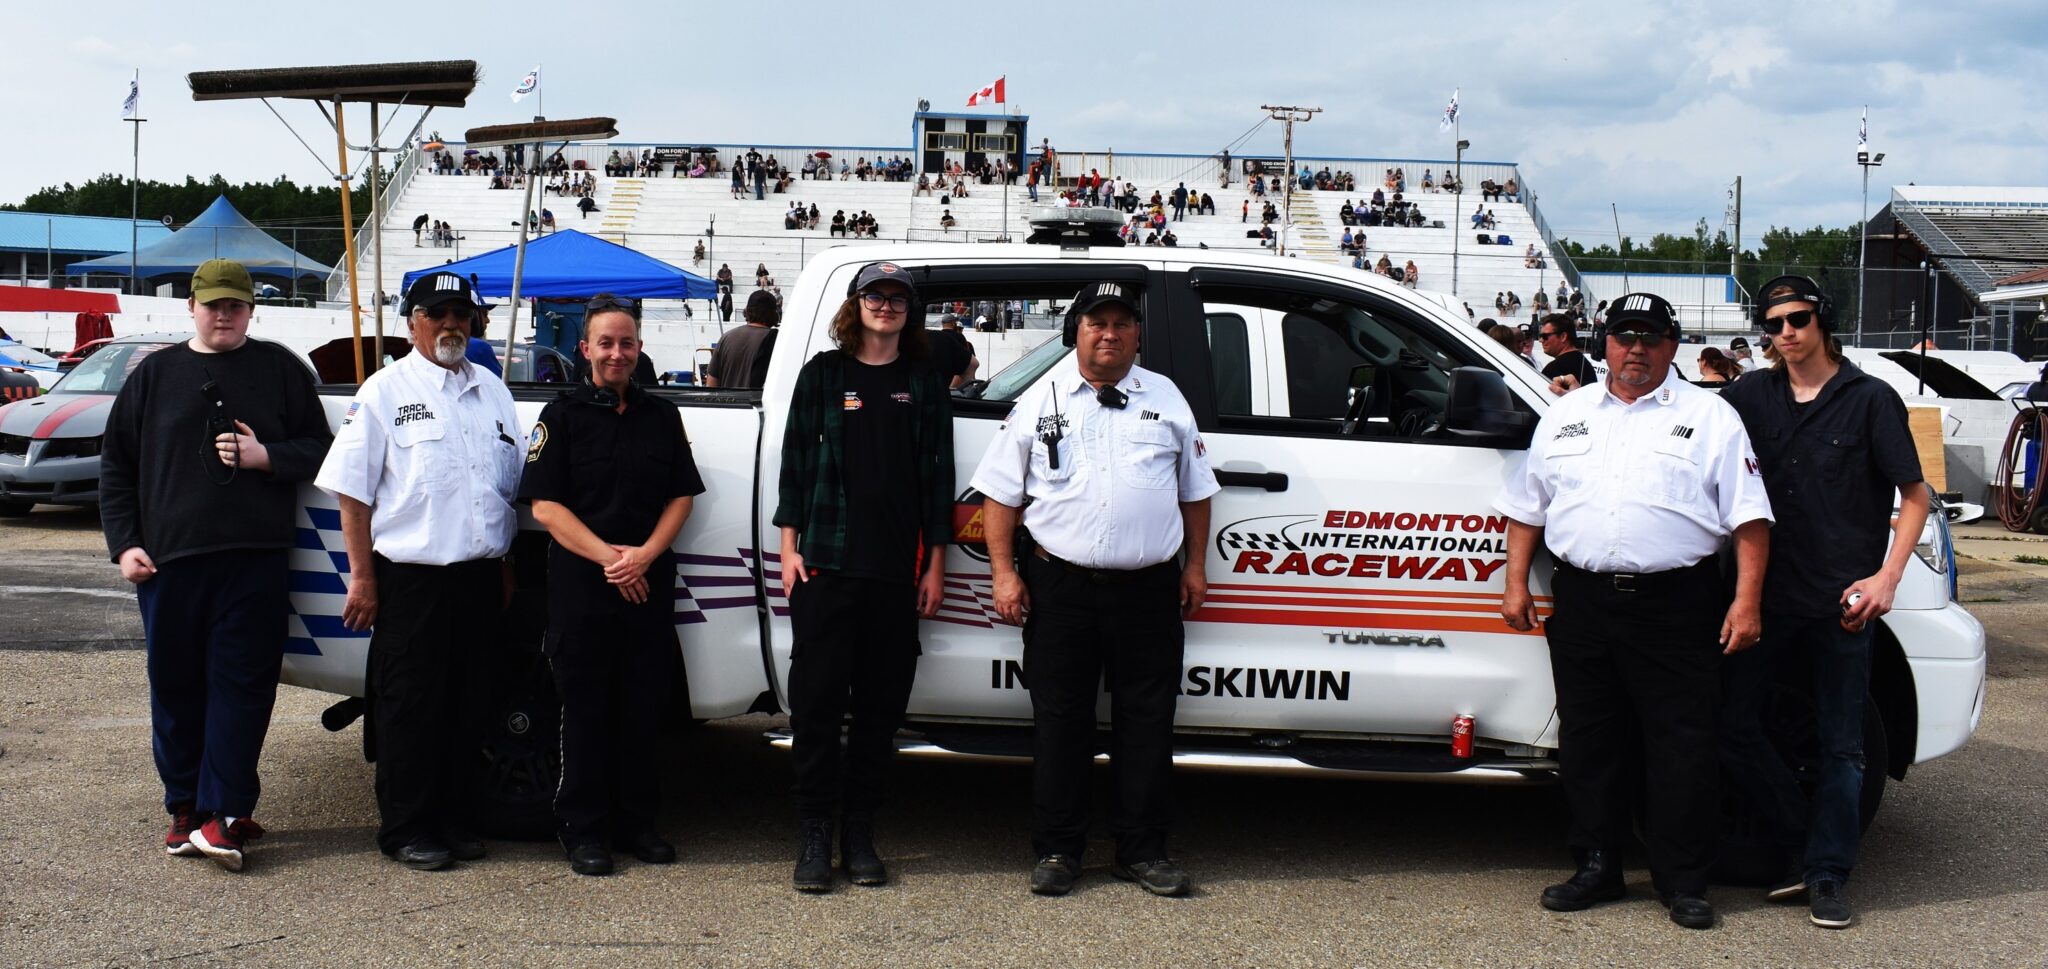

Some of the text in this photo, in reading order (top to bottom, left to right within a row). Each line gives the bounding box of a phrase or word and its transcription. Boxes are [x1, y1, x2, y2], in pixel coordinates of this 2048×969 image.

[395, 411, 435, 426] OFFICIAL
[398, 403, 427, 416] TRACK
[1036, 420, 1069, 432] OFFICAL
[1323, 510, 1510, 534] EDMONTON
[1301, 532, 1508, 554] INTERNATIONAL
[1232, 551, 1508, 582] RACEWAY
[1322, 630, 1446, 648] TUNDRA
[991, 659, 1031, 690] IN
